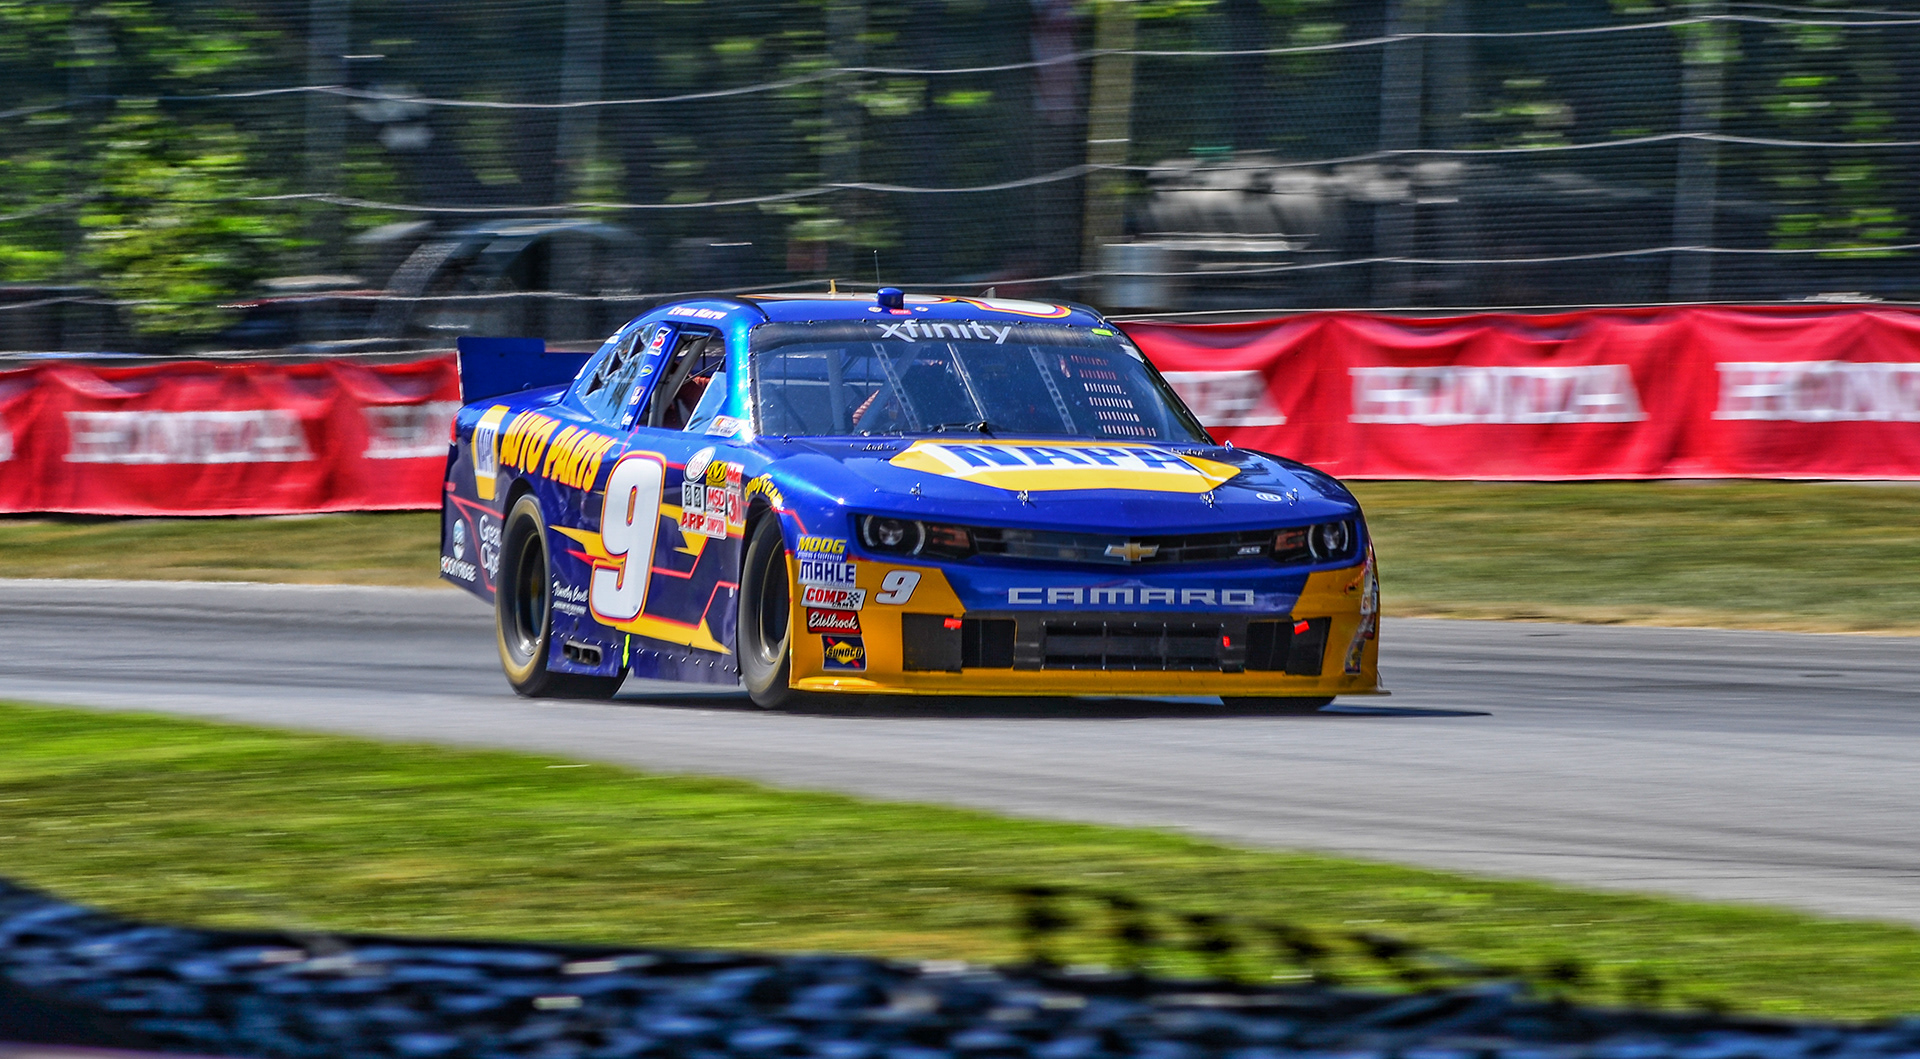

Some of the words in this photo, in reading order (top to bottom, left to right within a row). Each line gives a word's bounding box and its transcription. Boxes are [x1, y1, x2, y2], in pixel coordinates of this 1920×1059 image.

[877, 319, 1011, 344] xfinity
[499, 411, 560, 474] AUTO
[541, 424, 617, 493] PARTS
[942, 445, 1197, 471] NAPA
[680, 511, 706, 530] ARP
[589, 449, 667, 627] 9
[796, 536, 847, 554] MOOG
[800, 561, 855, 583] MAHLE
[806, 588, 848, 603] COMP
[875, 570, 922, 605] 9
[1008, 587, 1254, 605] CAMARO
[825, 646, 863, 660] SUNOCO
